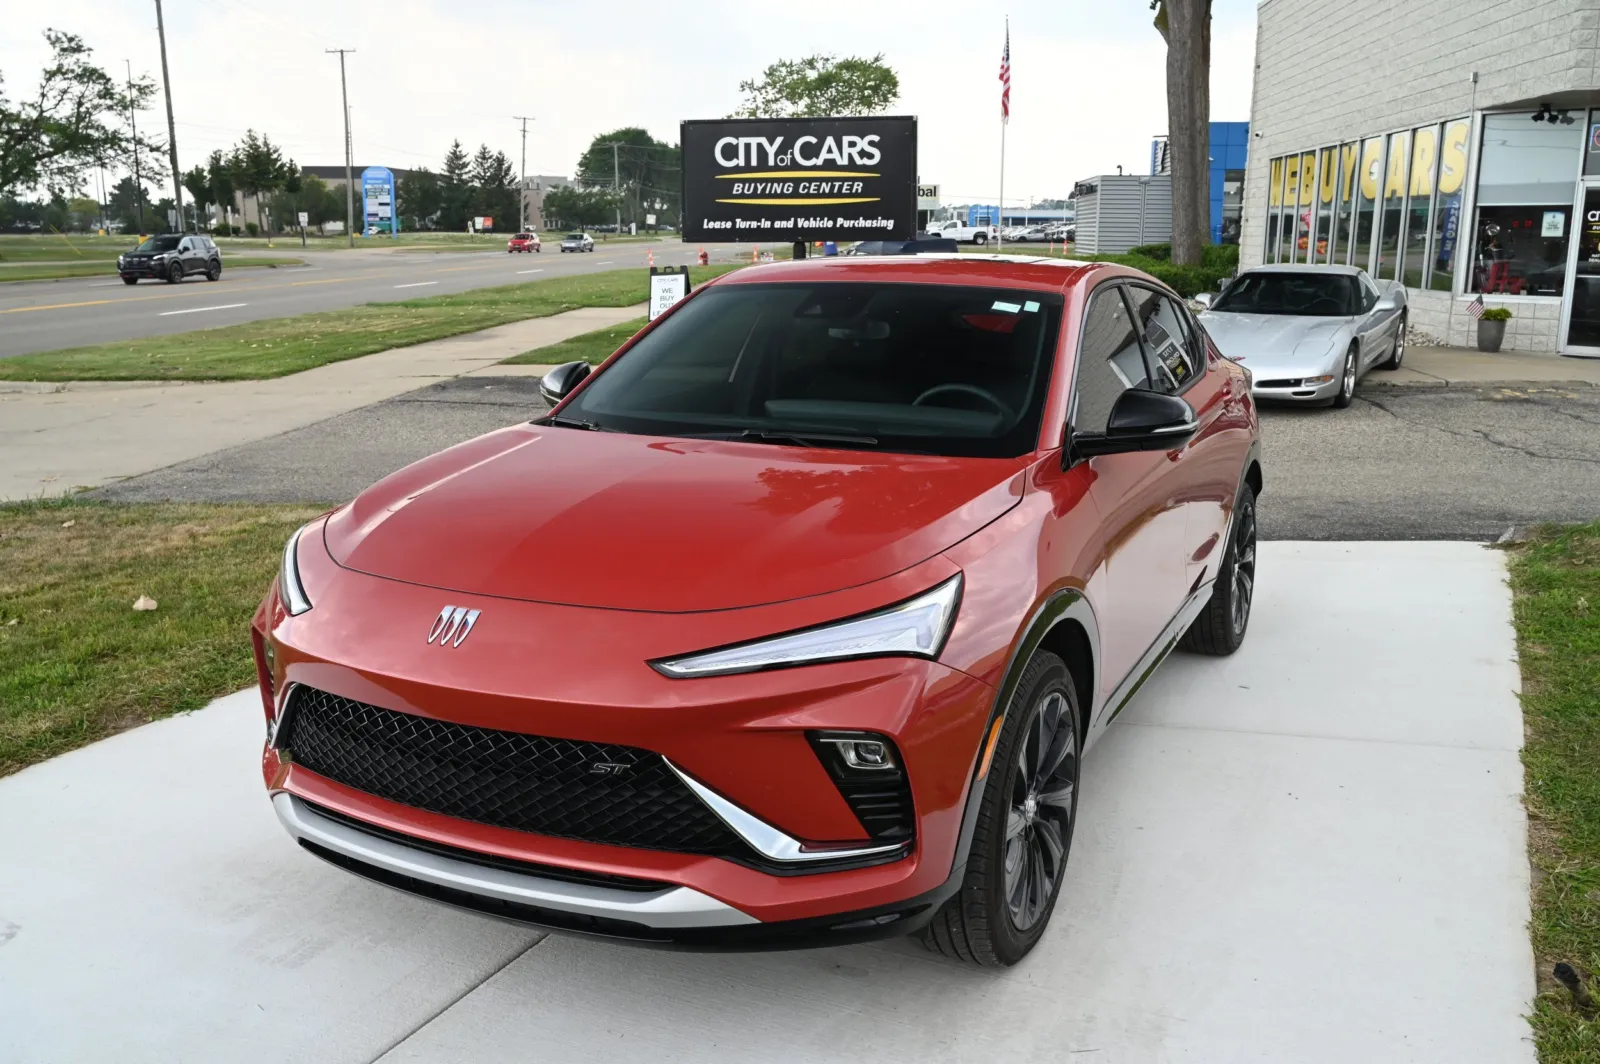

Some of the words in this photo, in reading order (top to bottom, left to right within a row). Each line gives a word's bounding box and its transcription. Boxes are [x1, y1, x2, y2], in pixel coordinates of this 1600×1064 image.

[714, 136, 784, 167] CITY
[776, 149, 793, 166] of
[793, 134, 881, 166] CARS
[1299, 143, 1358, 206] BUY
[1359, 122, 1468, 201] CARS
[732, 182, 794, 195] BUYING
[798, 181, 863, 194] CENTER
[703, 218, 732, 229] Lease
[735, 218, 771, 229] Turn-In
[774, 218, 794, 229] and
[796, 217, 834, 229] Vehicle
[836, 217, 895, 231] Purchasing
[589, 762, 631, 775] ST
